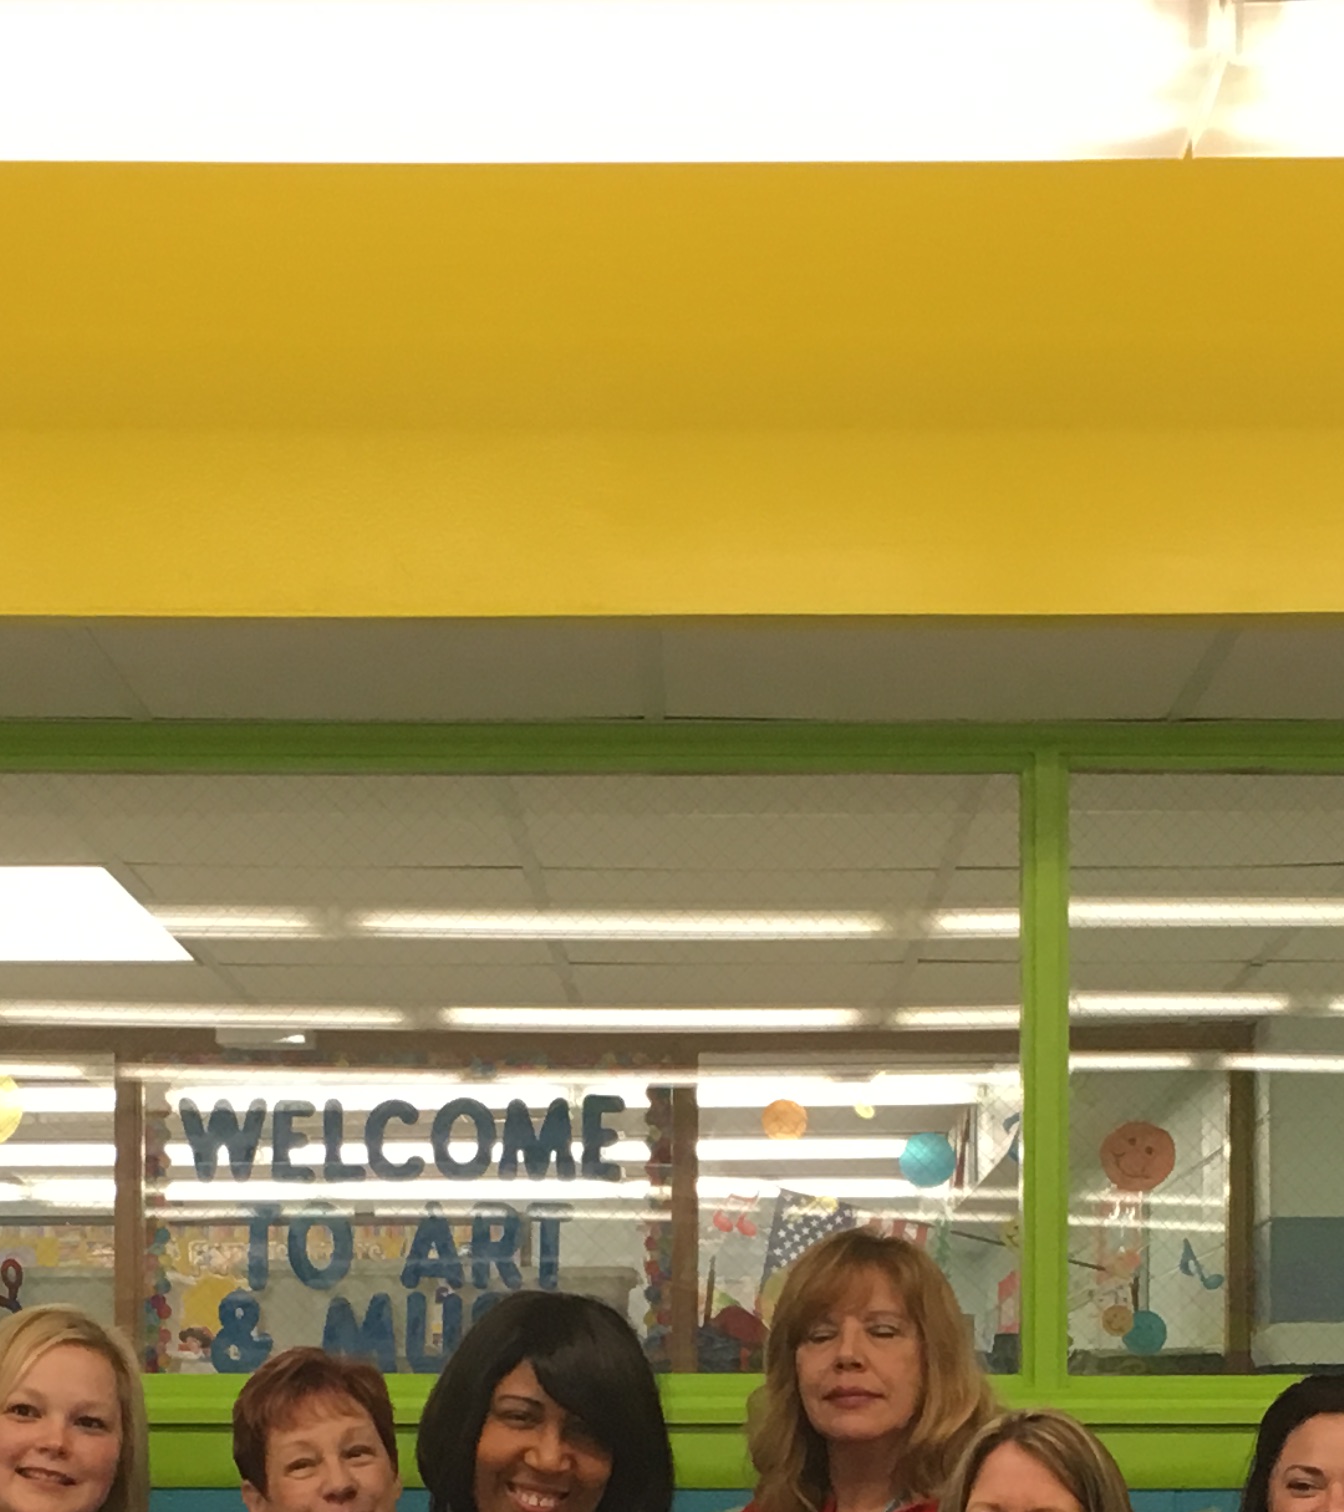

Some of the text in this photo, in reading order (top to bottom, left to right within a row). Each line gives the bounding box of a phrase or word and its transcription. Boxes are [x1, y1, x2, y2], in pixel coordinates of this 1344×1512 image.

[178, 1094, 626, 1184] WELCOME
[241, 1200, 575, 1292] TO ART
[210, 1288, 274, 1374] &
